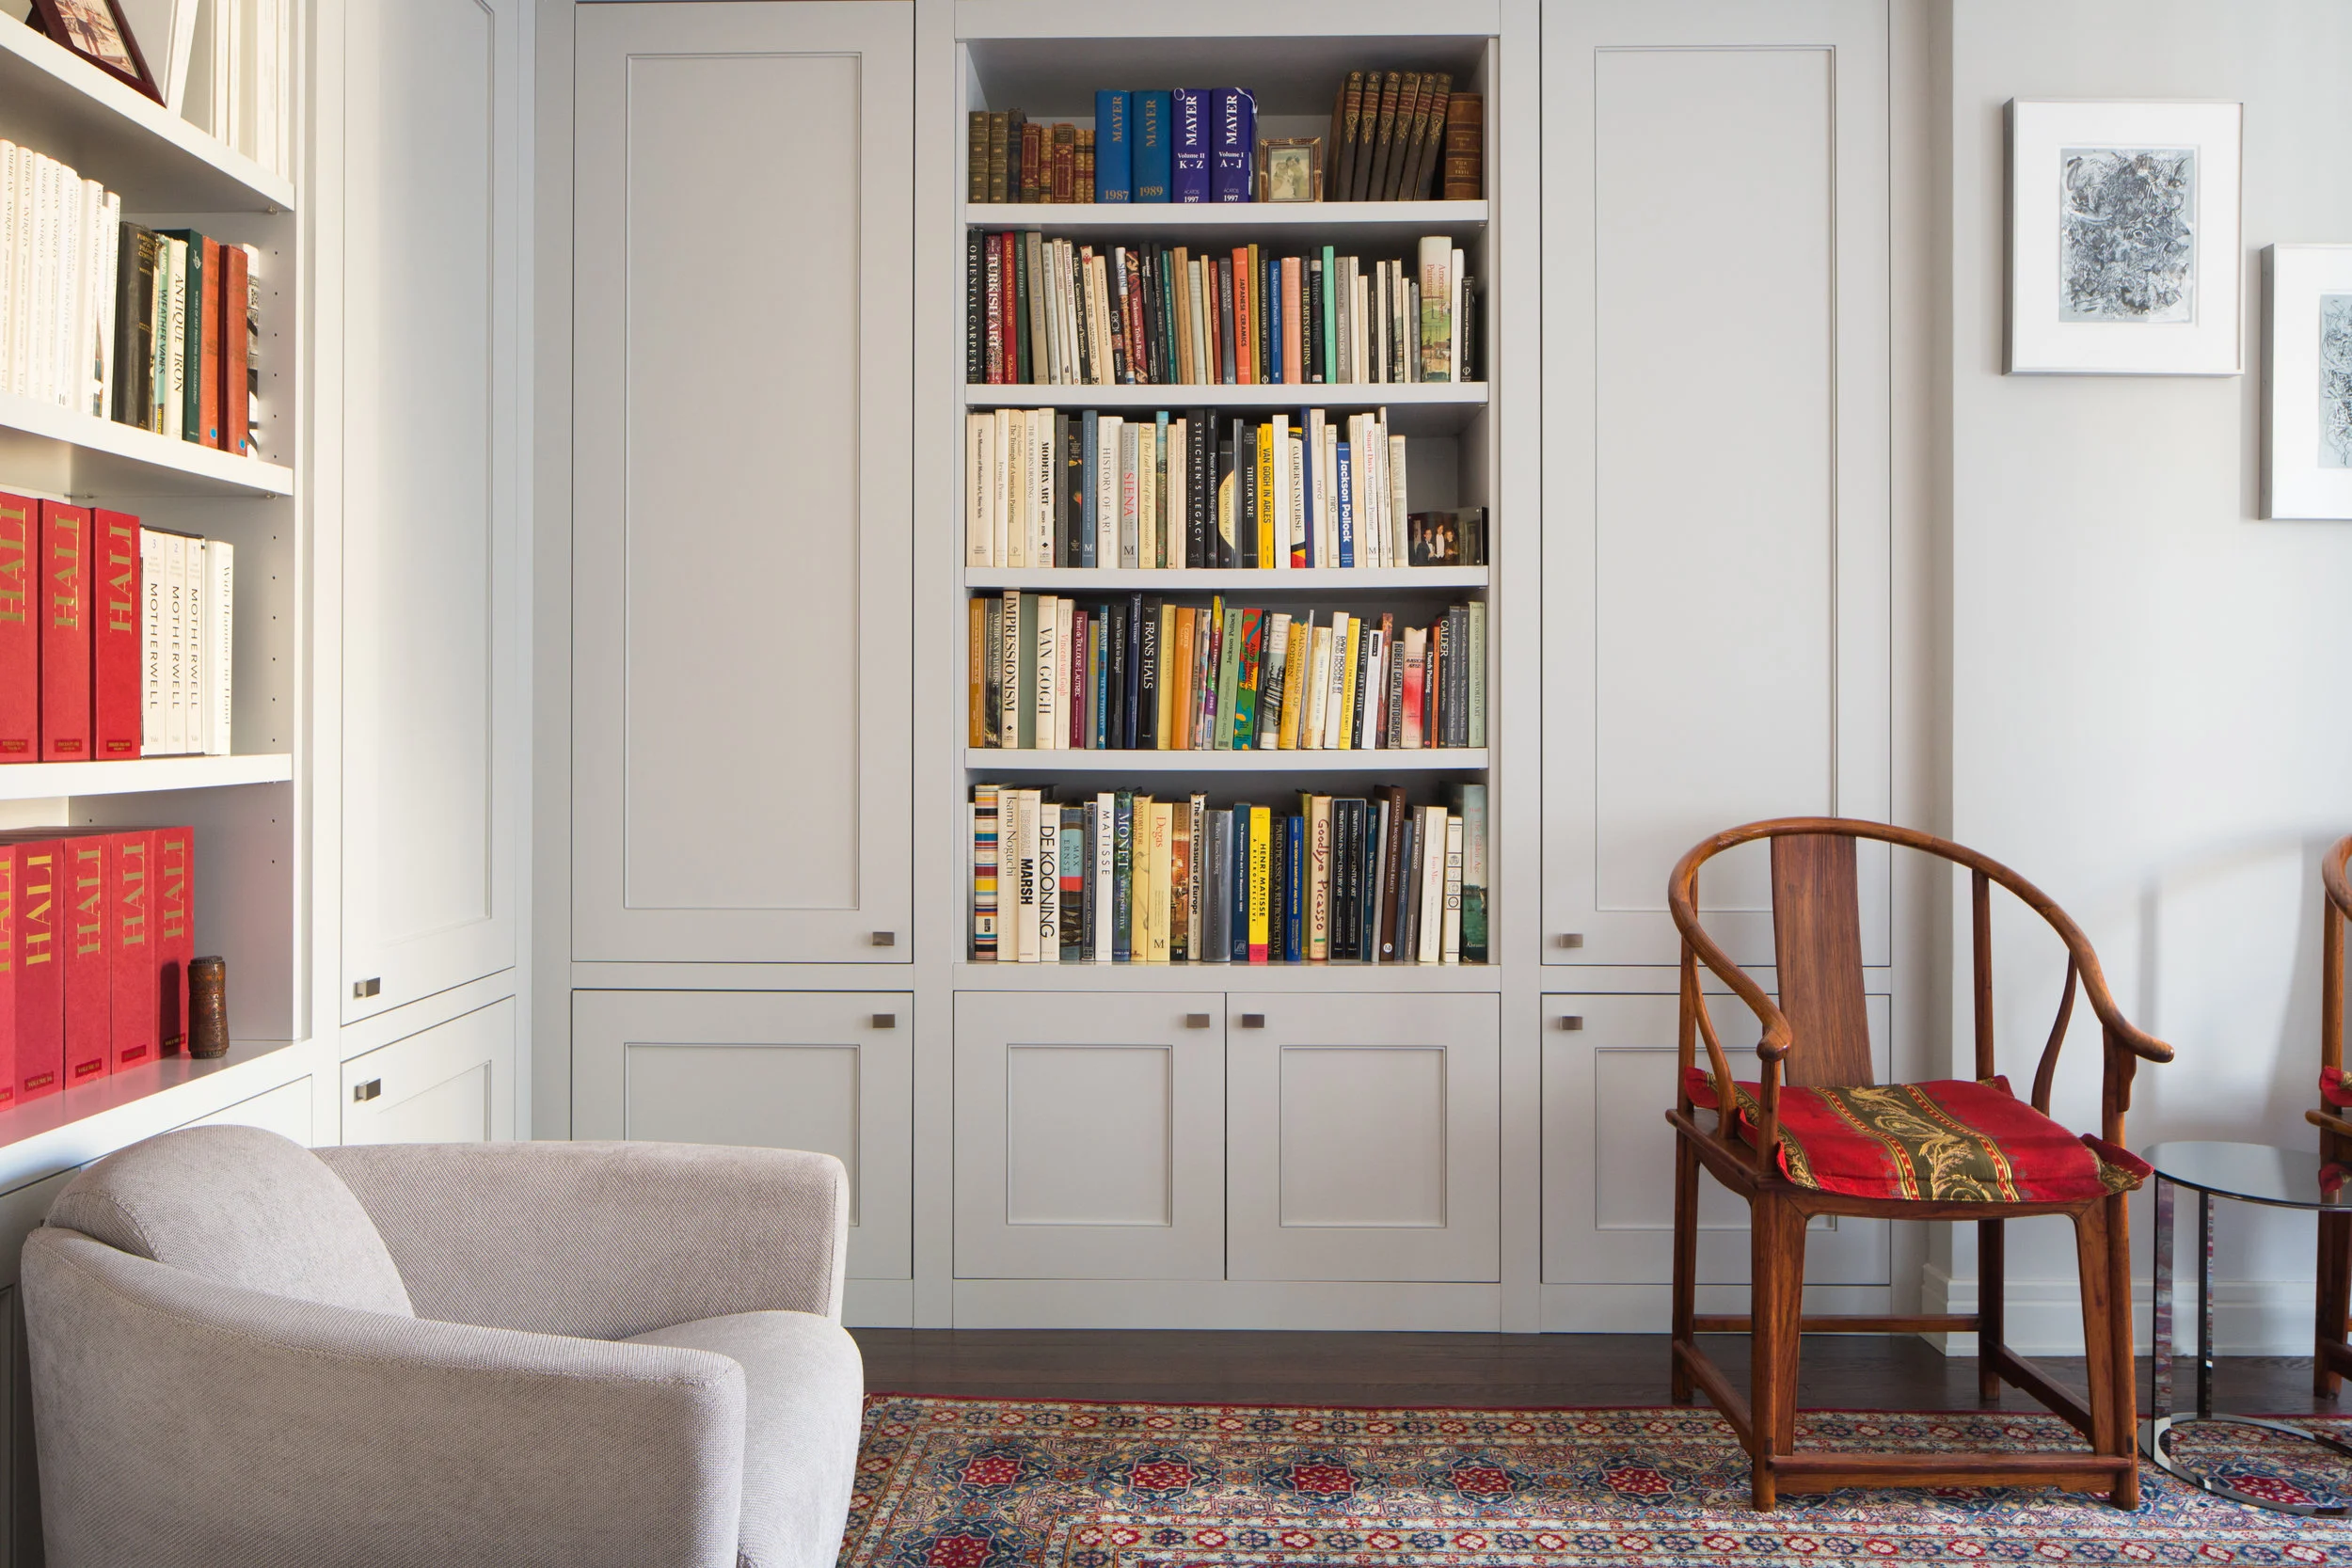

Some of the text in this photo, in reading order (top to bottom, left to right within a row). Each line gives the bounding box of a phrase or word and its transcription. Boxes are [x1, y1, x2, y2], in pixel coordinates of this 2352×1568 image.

[1113, 96, 1122, 142] MAYER
[1146, 100, 1156, 147] MAYER
[1186, 96, 1197, 145] MAYER
[1226, 95, 1237, 145] MAYER
[1105, 190, 1129, 200] 1987
[1140, 186, 1163, 196] 1989
[157, 289, 167, 375] WEATHER VANES
[174, 273, 184, 393] ANTIQUE IRON
[988, 253, 999, 350] TURKISH ART
[1303, 326, 1310, 336] OF
[1102, 448, 1111, 534] HISTORY OF ART
[1123, 472, 1135, 516] SIENA
[1294, 487, 1302, 531] UNIVERSE
[1340, 460, 1351, 542] Jackson Pollock
[0, 503, 26, 626] HALI
[54, 514, 80, 632] HALI
[109, 522, 133, 636] HALI
[150, 582, 159, 709] MOTHERWELL
[171, 585, 181, 709] MOTHERWELL
[1004, 596, 1016, 712] IMPRESSIONISM
[1057, 634, 1068, 696] Vincent van Gogh
[1074, 638, 1083, 697] TOULOUSE-LAUTREC
[1143, 622, 1154, 689] FRANS HALS
[1287, 639, 1296, 677] MODERN
[1293, 626, 1306, 709] MAINSTREAMS OF
[1393, 643, 1403, 670] ROBERT
[1440, 620, 1449, 657] CALDER
[1039, 627, 1053, 715] VAN GOGH
[1337, 687, 1343, 695] BY
[1392, 672, 1402, 689] CAPA
[1391, 694, 1401, 743] PHOTOGRAPHS
[1004, 797, 1017, 877] Isamu Noguchi
[1102, 810, 1110, 876] MATISSE
[1118, 813, 1129, 870] MONET
[1153, 816, 1167, 847] Degas
[77, 845, 102, 960] HALI
[122, 841, 145, 949] HALI
[164, 837, 185, 942] HALI
[1021, 859, 1033, 905] MARSH
[1041, 826, 1055, 938] DE KOONING
[1191, 886, 1200, 915] Europe
[1193, 875, 1200, 884] of
[1312, 818, 1329, 931] Goodbye Picasso
[26, 852, 53, 968] HALI
